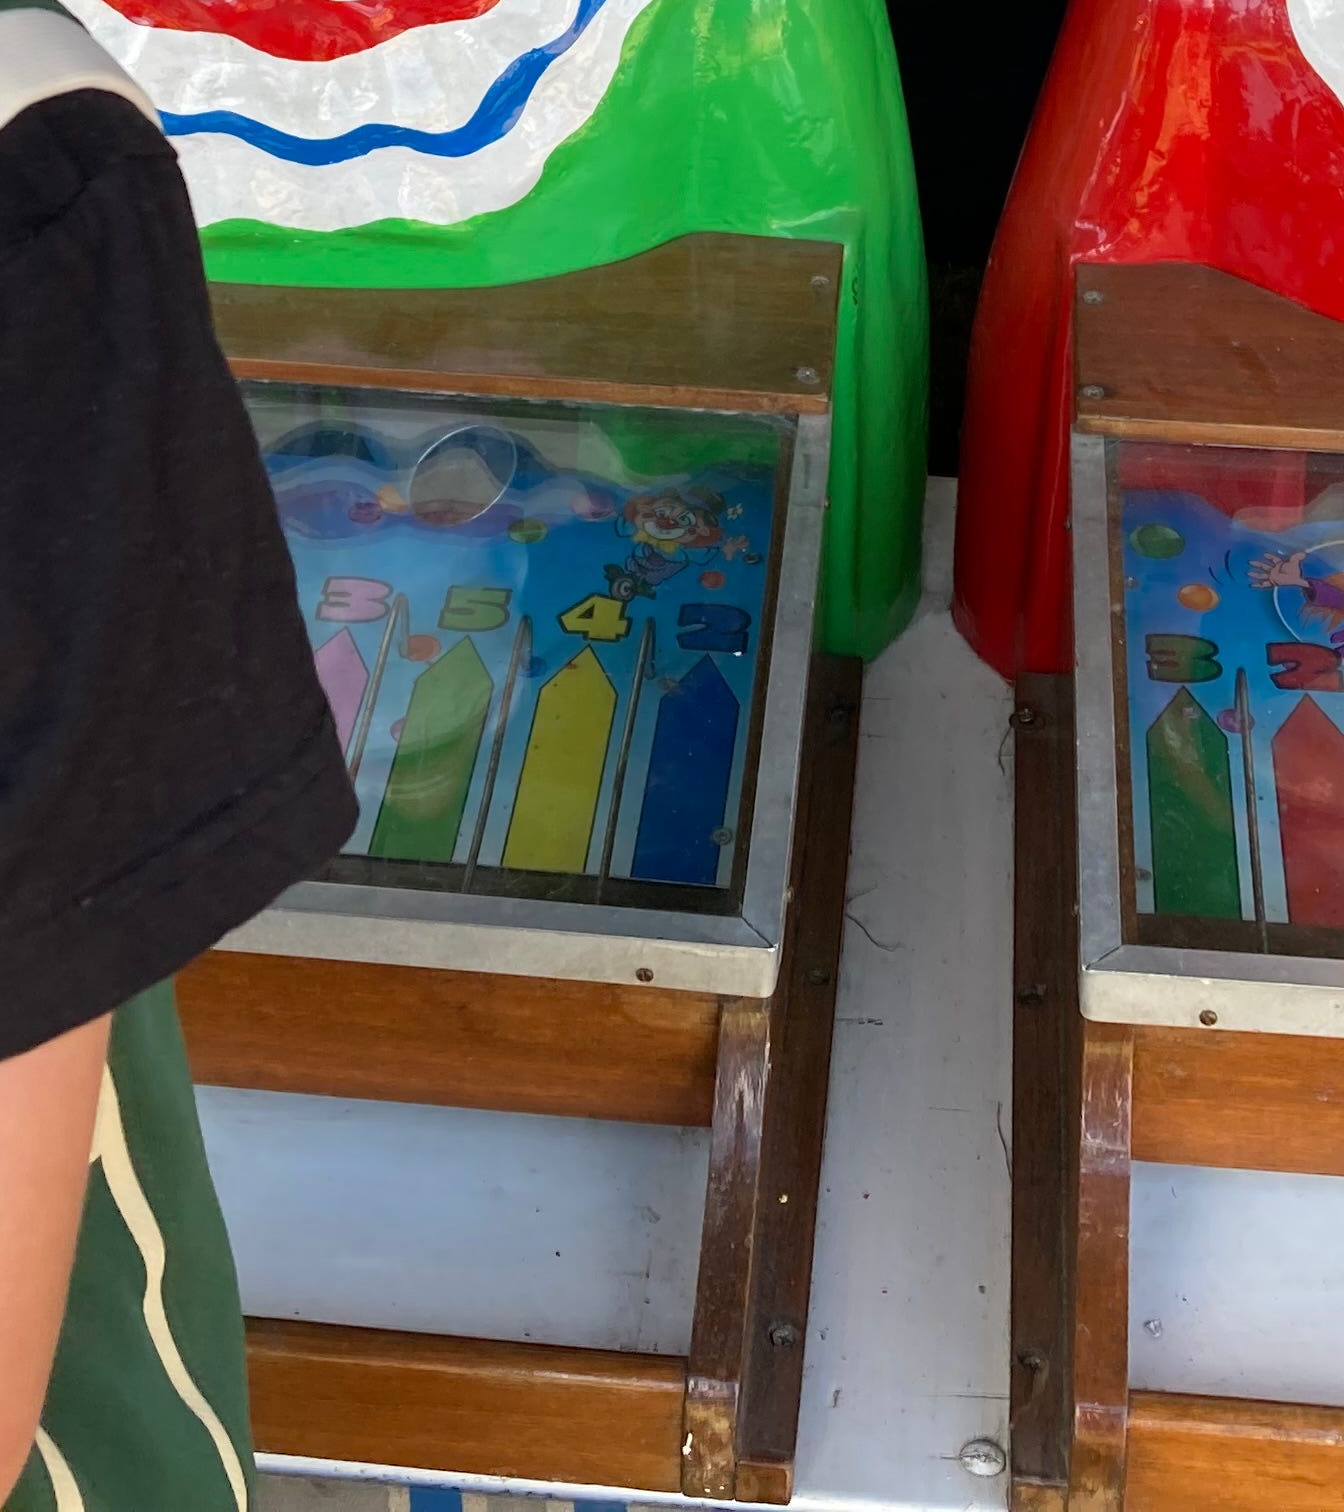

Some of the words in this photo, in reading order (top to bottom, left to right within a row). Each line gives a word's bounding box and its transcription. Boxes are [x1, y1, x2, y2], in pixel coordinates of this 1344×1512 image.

[316, 576, 393, 622] 3
[438, 585, 512, 631] 5
[559, 593, 632, 642] 4
[676, 603, 752, 653] 2
[1144, 633, 1223, 683] 3
